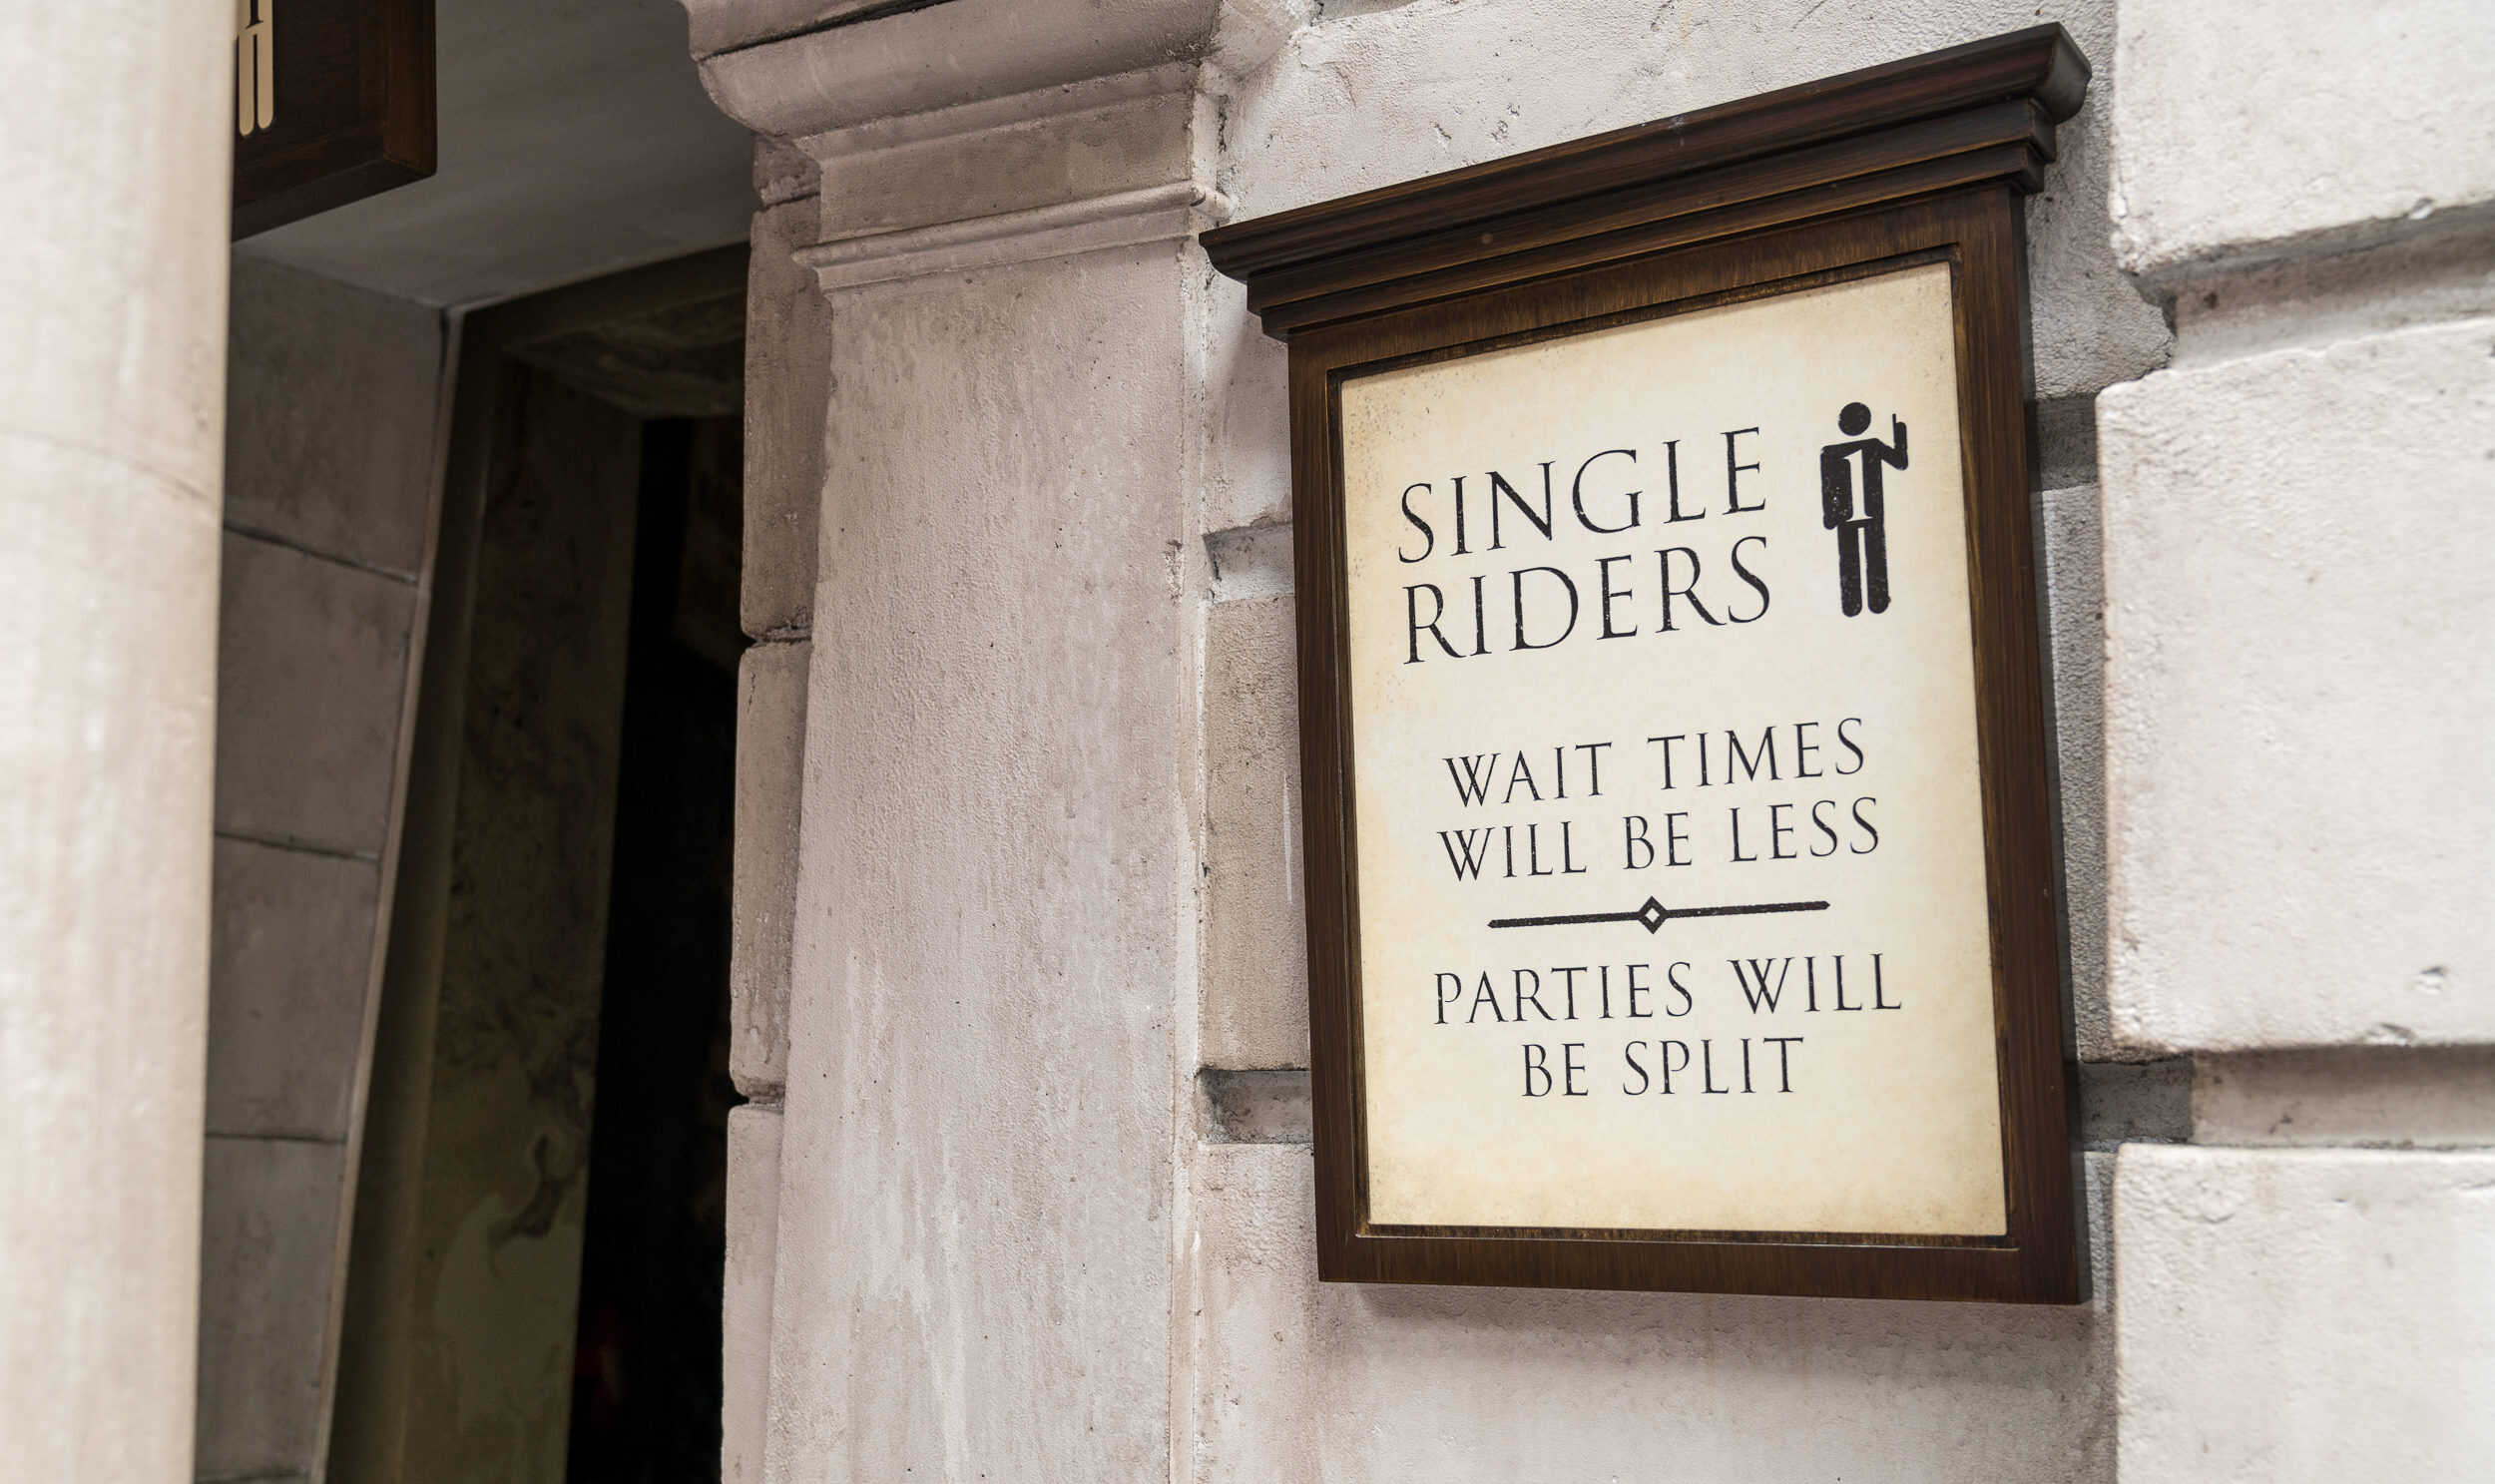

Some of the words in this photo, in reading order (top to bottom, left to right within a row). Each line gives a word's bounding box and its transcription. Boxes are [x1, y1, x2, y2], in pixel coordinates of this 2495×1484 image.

[1398, 427, 1767, 564] SINGLE
[1841, 448, 1874, 522] 1
[1402, 536, 1771, 666] RIDERS
[1442, 742, 1613, 807] WAIT
[1647, 717, 1865, 790] TIMES
[1436, 820, 1588, 882] WILL
[1623, 811, 1694, 870] BE
[1730, 795, 1880, 862] LESS
[1433, 961, 1694, 1025] PARTIES
[1727, 952, 1903, 1015] WILL
[1521, 1042, 1590, 1098] BE
[1623, 1037, 1805, 1096] SPLIT
